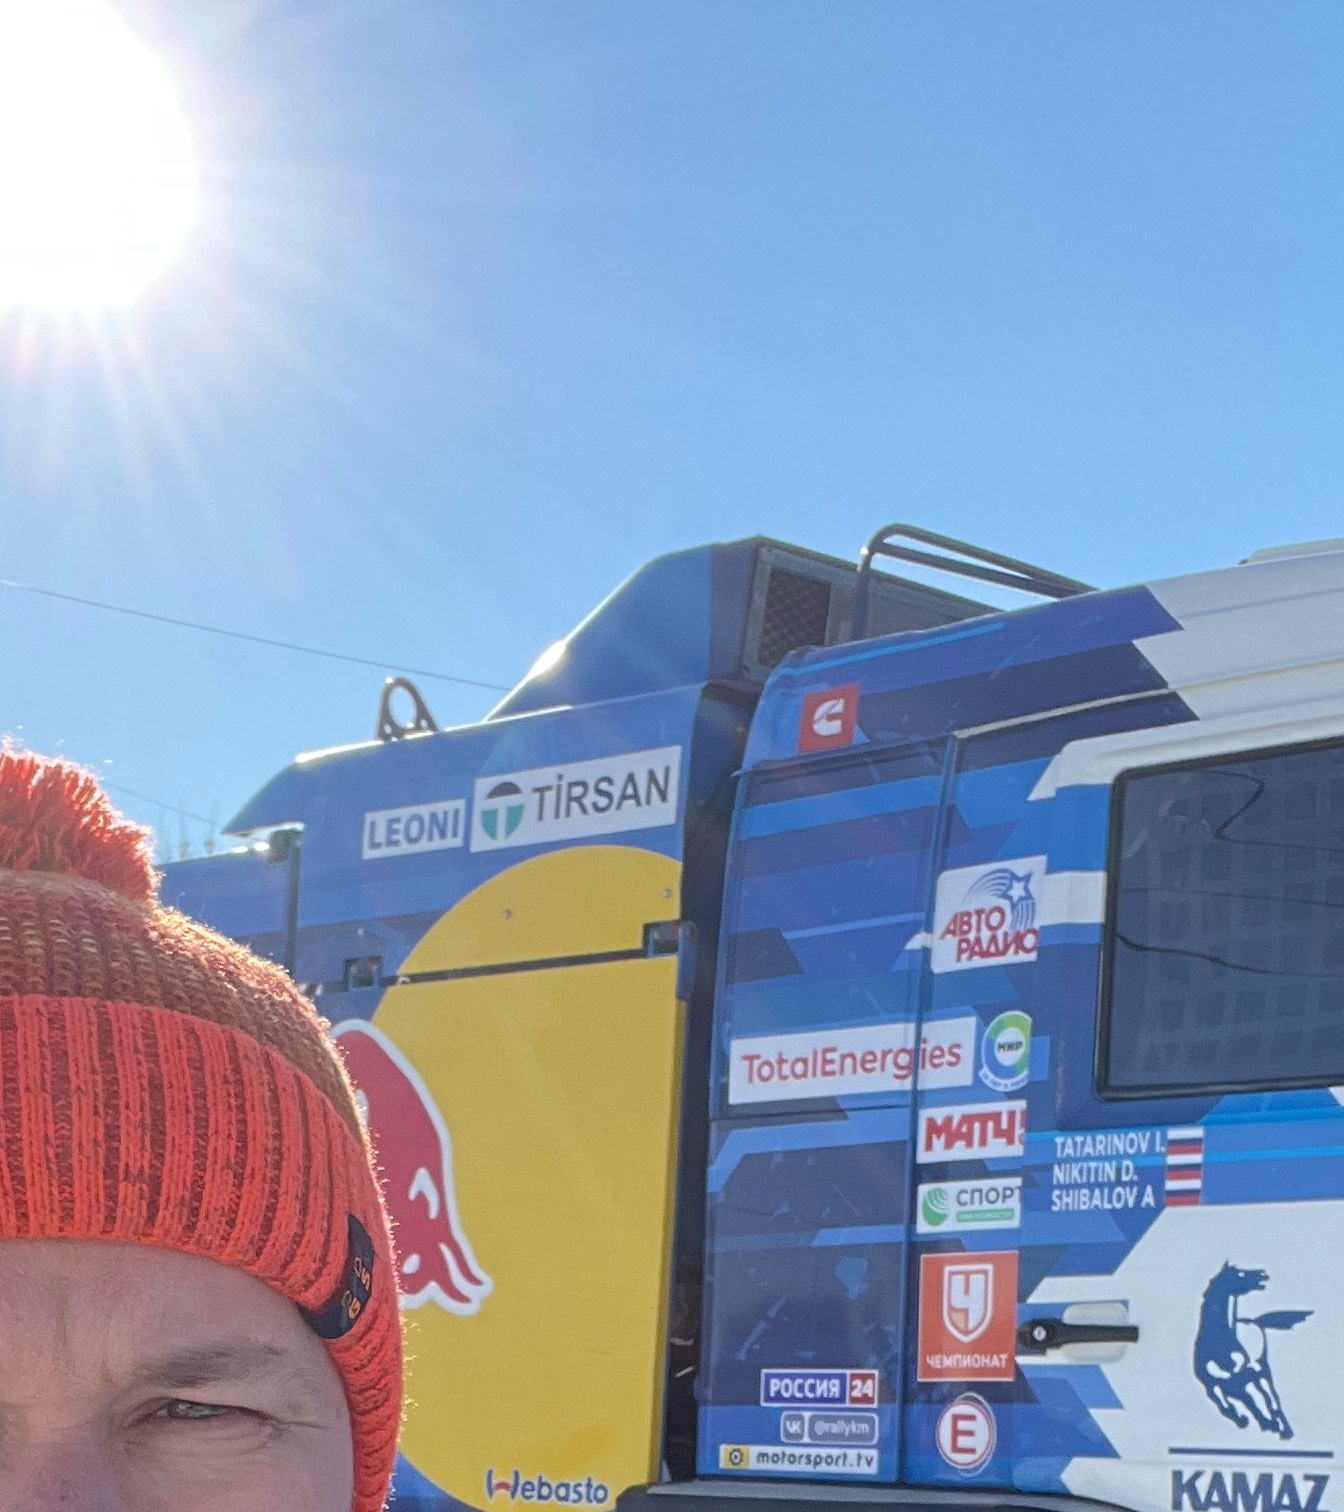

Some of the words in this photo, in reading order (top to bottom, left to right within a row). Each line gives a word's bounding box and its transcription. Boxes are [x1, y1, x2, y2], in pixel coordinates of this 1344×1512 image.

[367, 807, 460, 850] LEONI
[939, 905, 1006, 941] АВТО
[956, 928, 1039, 963] РАДИО
[741, 1037, 963, 1085] TotalEnergies
[1054, 1132, 1151, 1158] TATARINOV
[1052, 1160, 1116, 1185] NIKITIN
[1120, 1159, 1138, 1183] D.
[1050, 1186, 1138, 1212] SHIBALOV
[926, 1353, 1008, 1369] ЧЕМПИОНАТ
[769, 1374, 841, 1399] РОССИЯ
[850, 1376, 874, 1398] 24
[756, 1449, 875, 1468] motorsport.tv
[485, 1469, 609, 1505] Webasto
